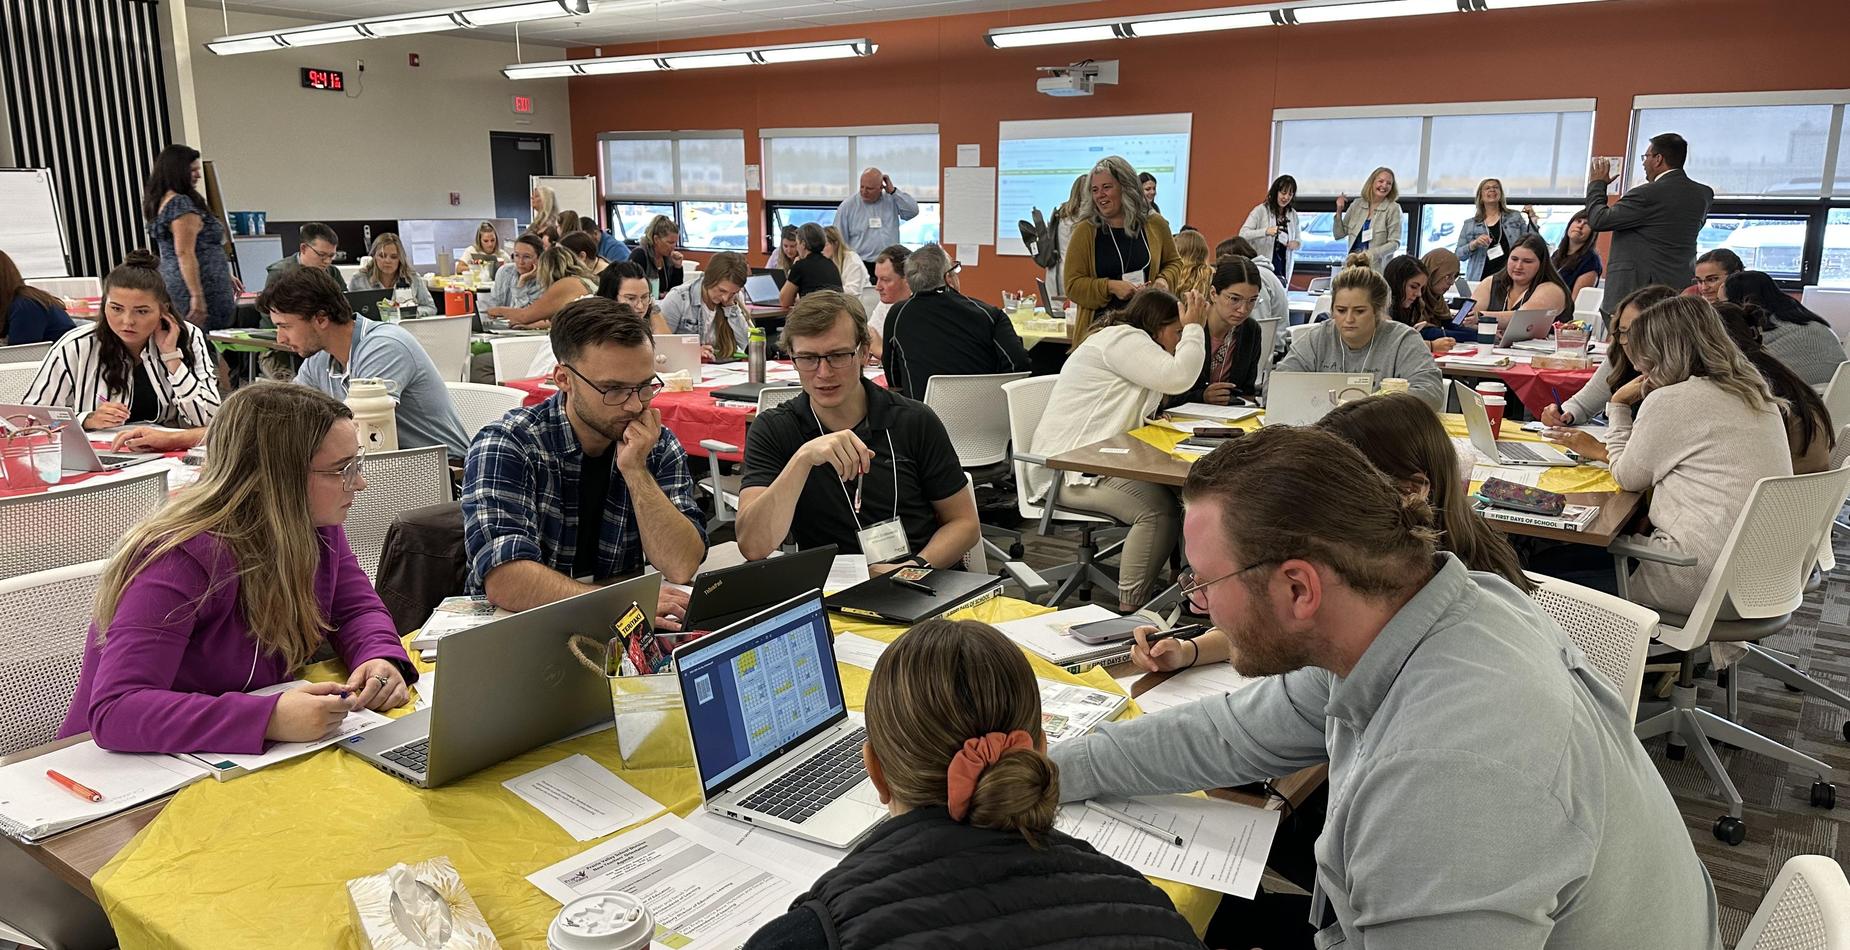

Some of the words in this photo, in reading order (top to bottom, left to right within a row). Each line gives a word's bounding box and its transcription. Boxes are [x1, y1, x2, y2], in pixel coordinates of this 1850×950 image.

[600, 854, 615, 864] Valley
[614, 847, 629, 857] School
[616, 854, 633, 865] Agenda
